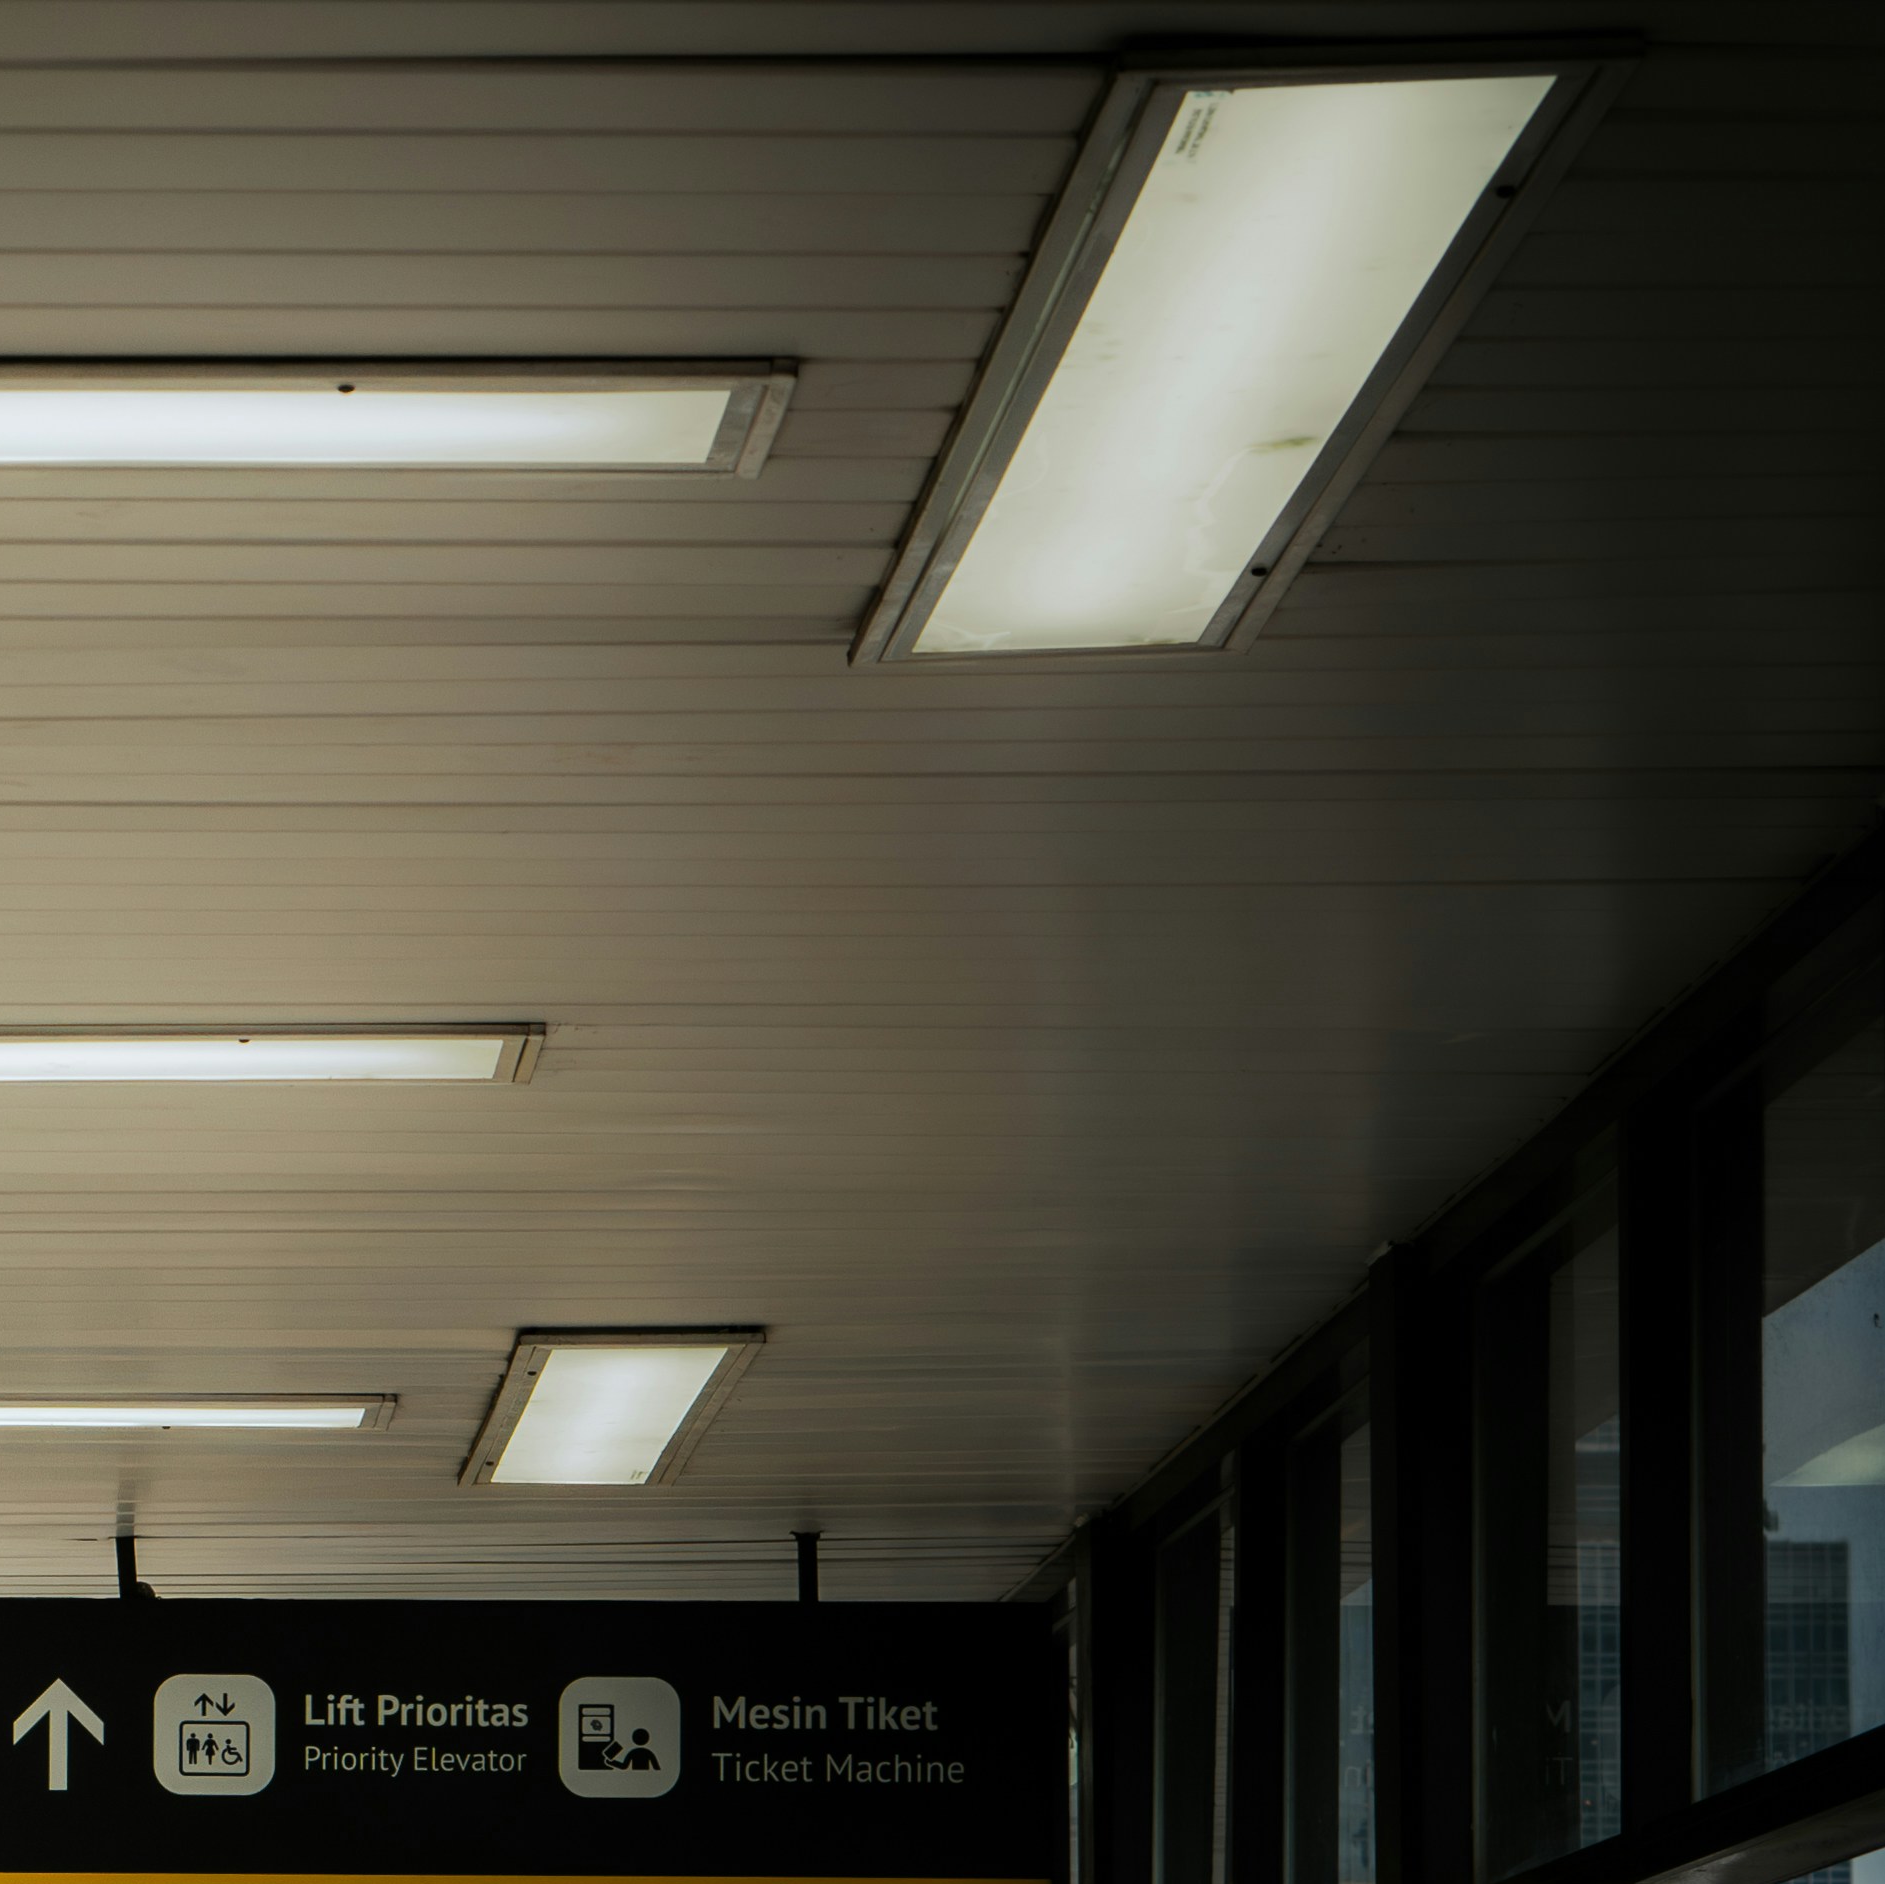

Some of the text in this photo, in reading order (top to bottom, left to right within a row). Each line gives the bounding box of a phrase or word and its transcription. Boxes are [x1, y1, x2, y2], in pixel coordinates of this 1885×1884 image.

[305, 1693, 529, 1727] Lift Prioritas
[713, 1695, 938, 1731] Mesin Tiket
[305, 1745, 527, 1778] Priority Elevator
[712, 1752, 965, 1784] Ticket Machine
